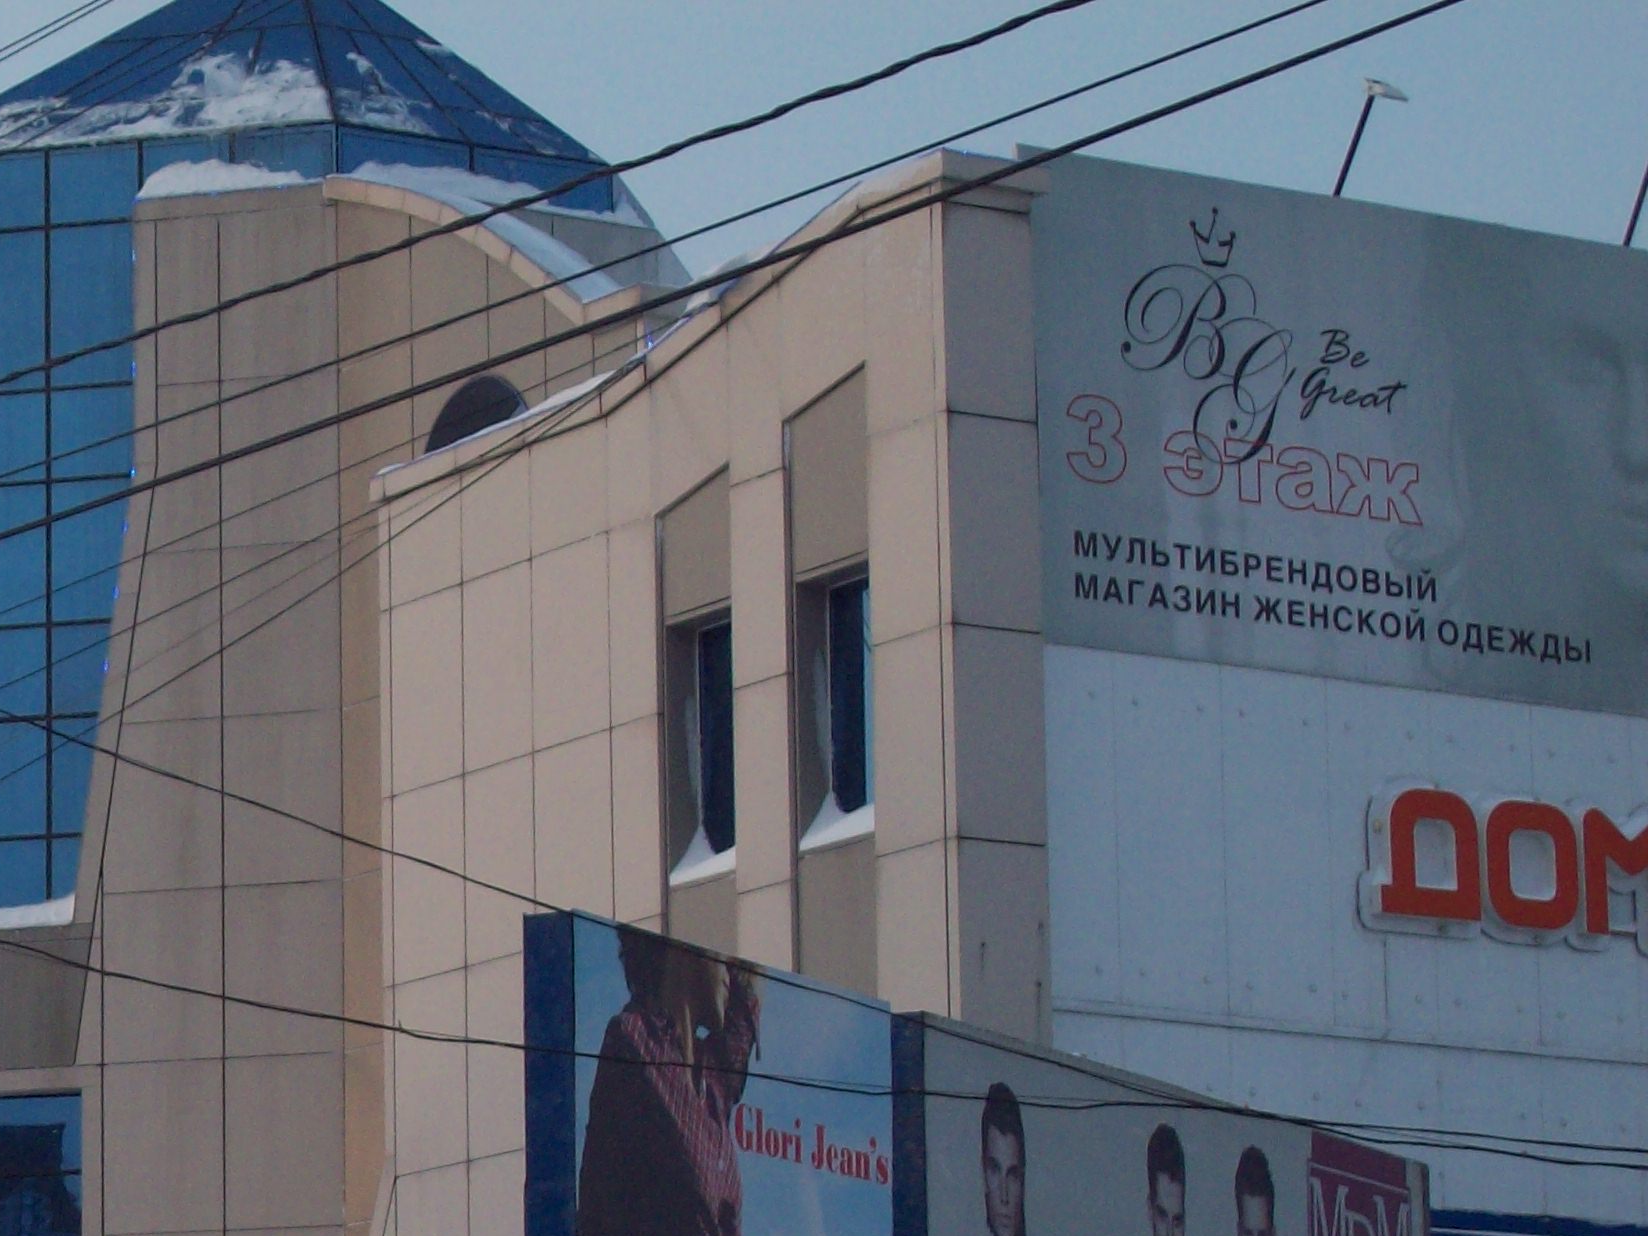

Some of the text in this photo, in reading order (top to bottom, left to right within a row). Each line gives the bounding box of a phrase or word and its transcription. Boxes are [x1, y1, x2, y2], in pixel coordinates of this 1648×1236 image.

[1320, 329, 1370, 368] Be
[1300, 367, 1406, 419] Great
[1066, 394, 1423, 526] 3 этаж
[1073, 529, 1438, 603] МУЛЬТИБРЕНДОВЫЙ
[1073, 572, 1592, 665] МАГАЗИН ЖЕНСКОЙ ОДЕЖДЫ
[1380, 787, 1648, 936] ДОМ
[734, 1102, 890, 1186] Glori Jean's
